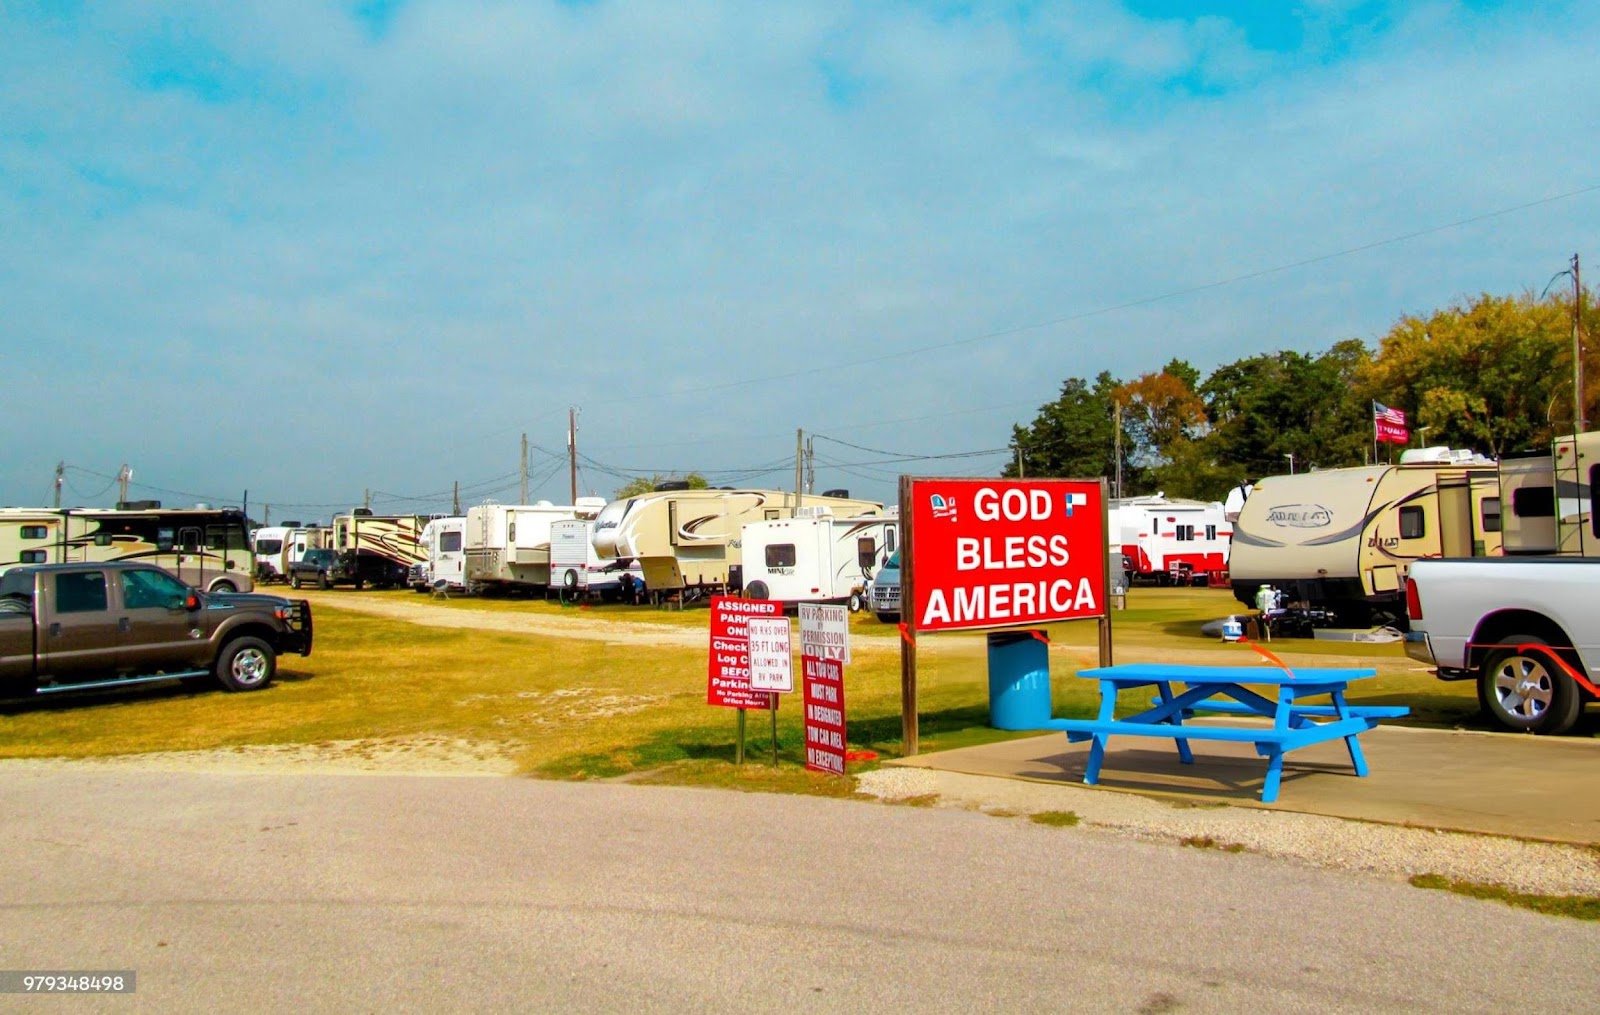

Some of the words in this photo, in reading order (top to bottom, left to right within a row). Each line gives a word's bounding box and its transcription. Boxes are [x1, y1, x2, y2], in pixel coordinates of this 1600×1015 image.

[974, 487, 1053, 522] GOD
[957, 534, 1070, 571] BLESS
[717, 601, 776, 613] ASSIGNED
[922, 577, 1096, 625] AMERICA
[801, 607, 810, 620] RV
[812, 608, 844, 622] PARKING
[751, 626, 758, 635] NO
[773, 626, 788, 636] OVER
[817, 622, 824, 630] BY
[802, 630, 844, 645] PERMISSION
[713, 641, 748, 652] Check
[751, 640, 760, 652] 35
[761, 641, 769, 652] FT
[771, 641, 789, 653] LONG
[804, 645, 844, 660] ONLY
[717, 653, 737, 666] Log
[753, 658, 779, 668] ALLOWED
[782, 658, 788, 668] IN
[721, 666, 750, 677] BEFO
[758, 672, 766, 682] RV
[769, 673, 784, 683] PARK
[806, 660, 817, 677] ALL
[815, 661, 827, 679] TOW
[827, 663, 840, 682] CARS
[712, 678, 748, 689] Parkin
[727, 690, 753, 699] Parking
[811, 682, 825, 700] MUST
[825, 685, 838, 703] PARK
[723, 697, 744, 705] Office
[807, 703, 814, 719] IN
[807, 725, 819, 744] TOW
[819, 727, 830, 746] CAR
[807, 747, 816, 764] NO
